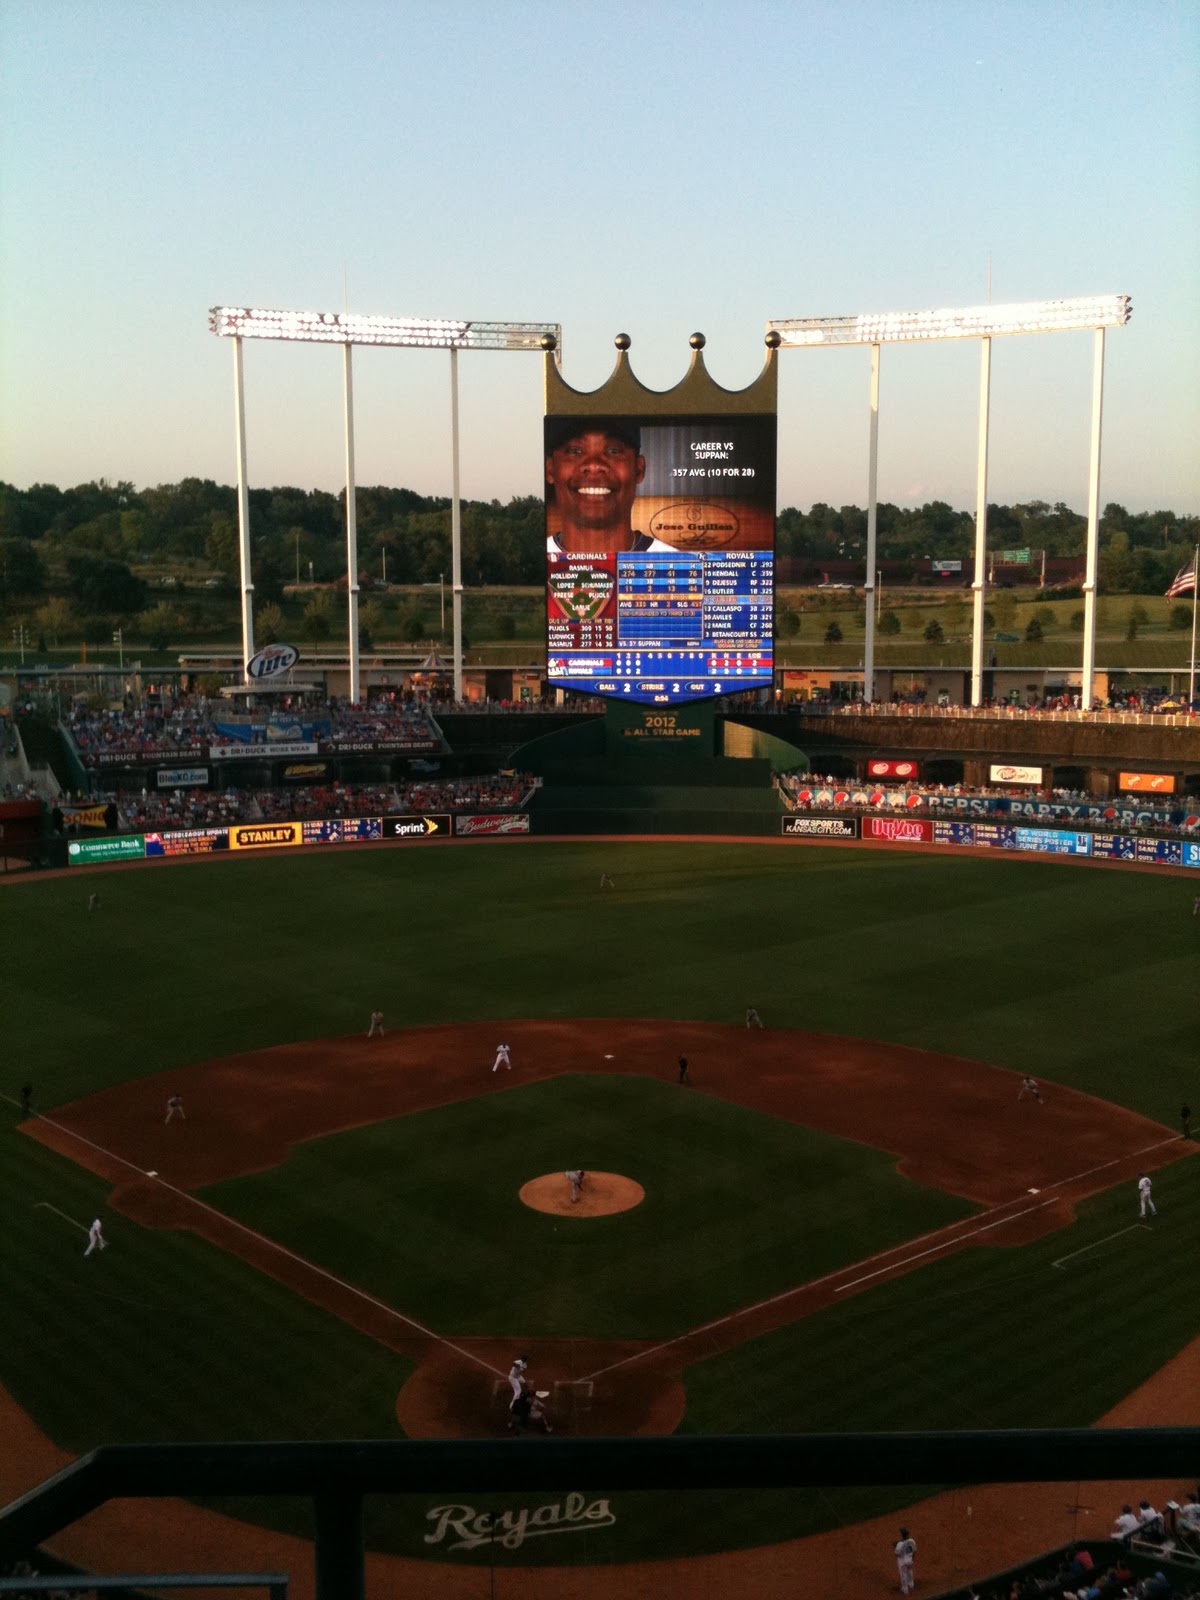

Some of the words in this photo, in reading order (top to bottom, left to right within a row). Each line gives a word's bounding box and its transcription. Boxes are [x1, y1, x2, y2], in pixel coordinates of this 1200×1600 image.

[695, 452, 729, 460] SUPPAN:
[689, 469, 706, 477] AVG
[708, 468, 721, 478] (10
[723, 469, 740, 477] FOR
[742, 468, 755, 478] 28)
[258, 653, 292, 677] Lite
[624, 684, 630, 692] 2
[673, 684, 679, 692] 2
[715, 684, 721, 692] 2
[646, 717, 676, 727] 2012
[142, 751, 178, 760] FOUNTAIN
[159, 773, 207, 783] BlueKC.com
[929, 797, 989, 808] PEPSI
[1010, 802, 1081, 816] PARTY
[64, 812, 105, 823] SONIC
[395, 824, 424, 835] Sprint
[240, 830, 292, 843] STANLEY
[81, 843, 120, 852] Commerce
[121, 839, 140, 848] Bank
[424, 1492, 616, 1550] Royals
